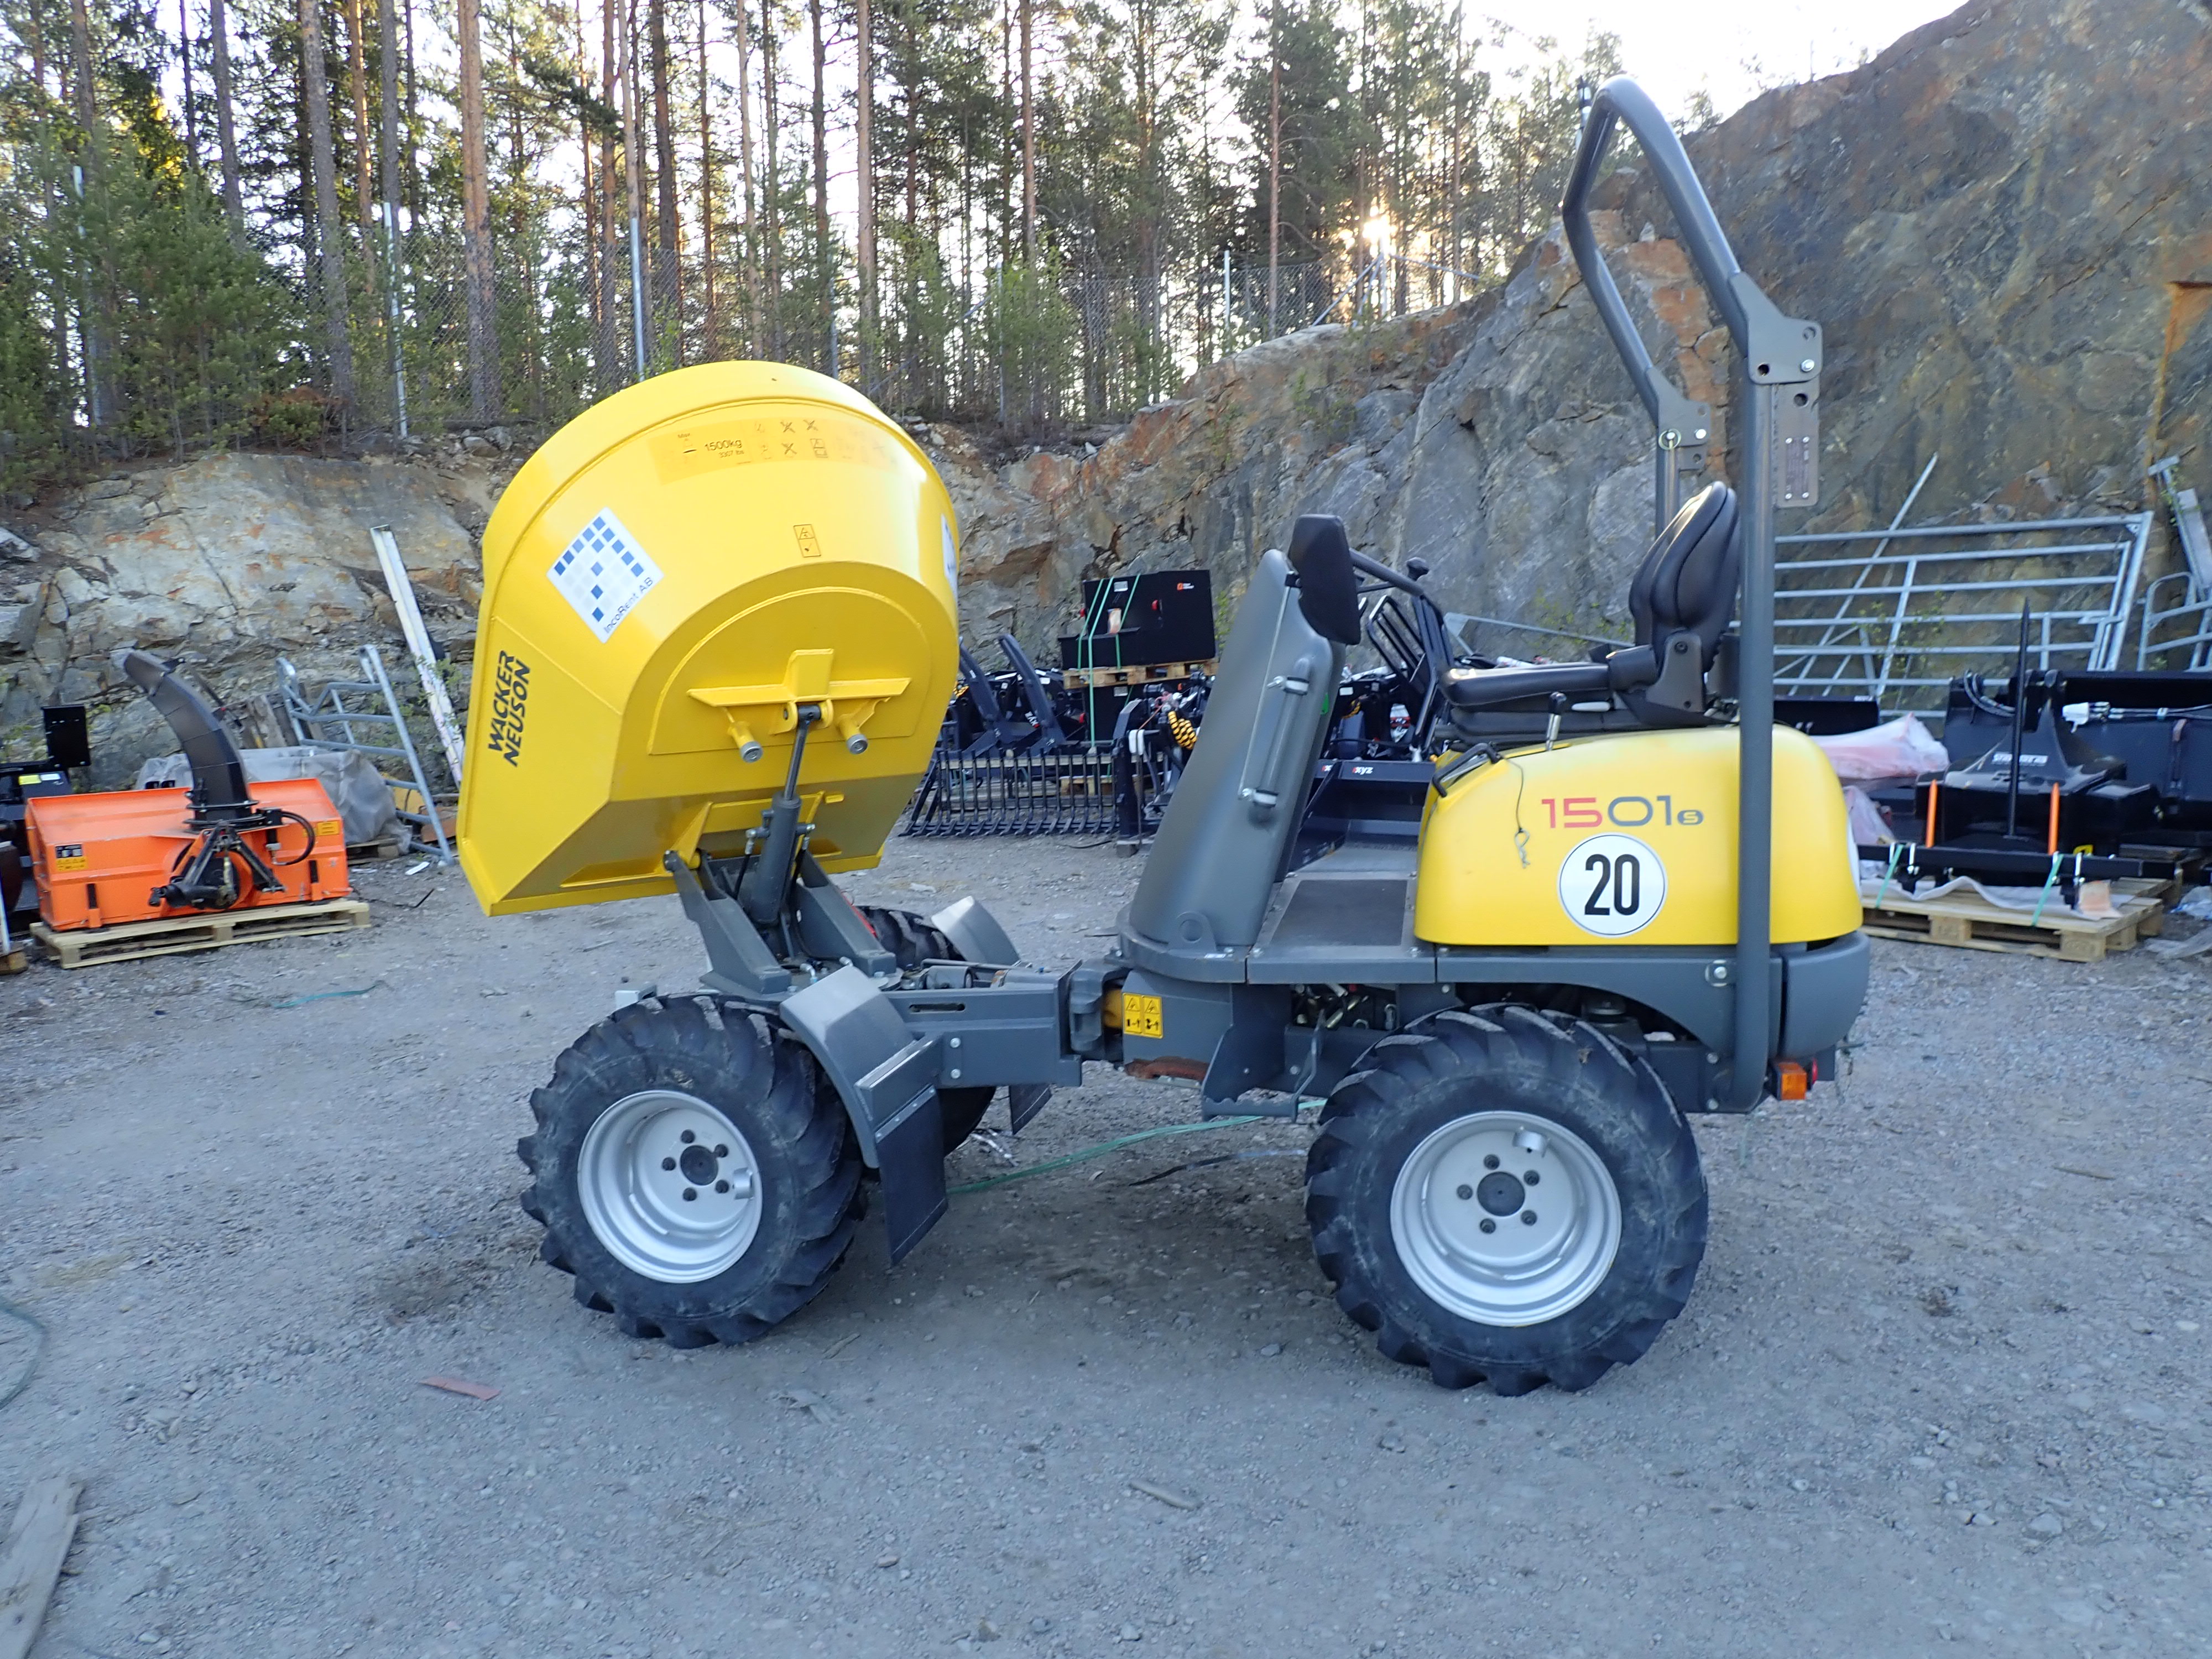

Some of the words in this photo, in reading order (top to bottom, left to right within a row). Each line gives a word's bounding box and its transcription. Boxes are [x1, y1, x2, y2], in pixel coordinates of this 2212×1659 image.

[705, 440, 742, 451] 1500kg
[639, 577, 653, 593] AB
[488, 650, 515, 752] WACKER
[503, 659, 530, 768] NEUSON
[1584, 854, 1640, 916] 20
